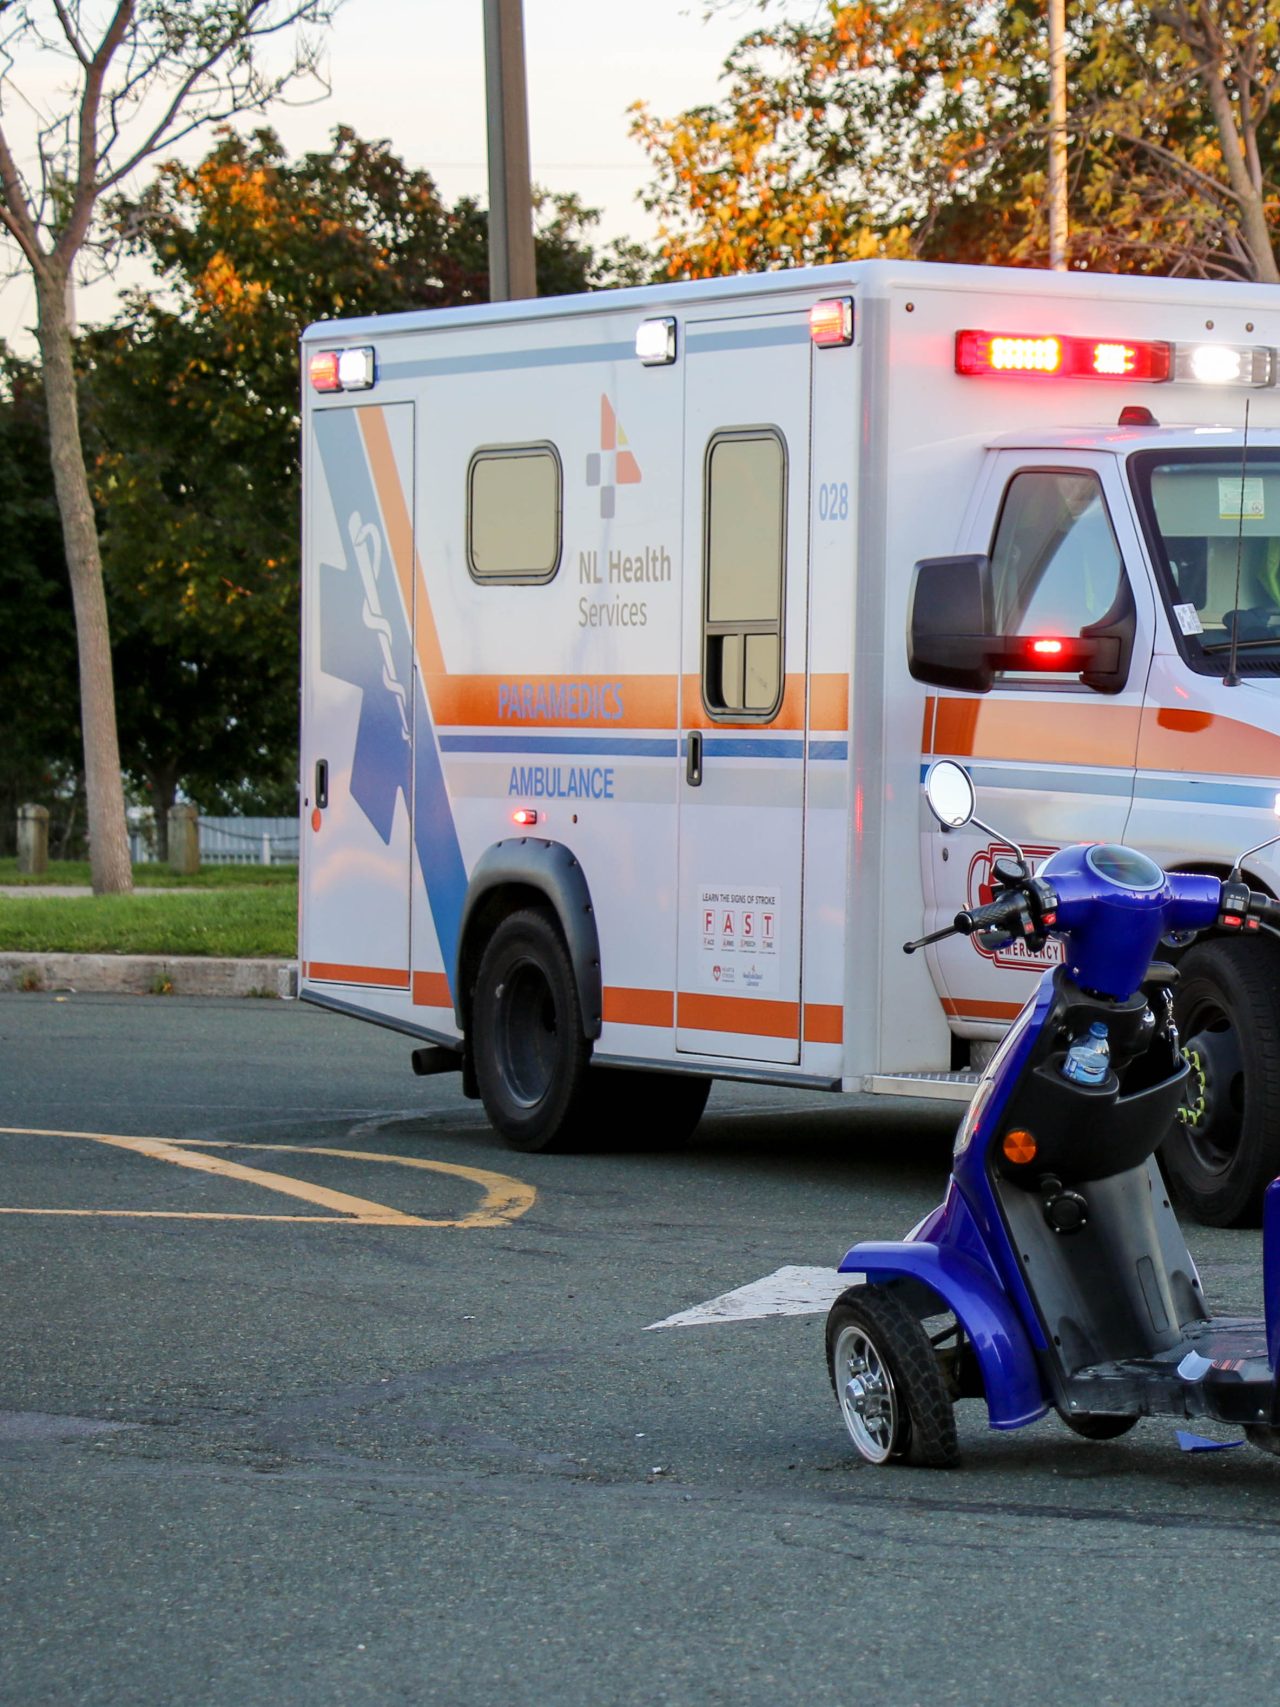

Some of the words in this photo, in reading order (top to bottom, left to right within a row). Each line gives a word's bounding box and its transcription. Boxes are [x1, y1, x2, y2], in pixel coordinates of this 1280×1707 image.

[819, 482, 849, 521] 028
[579, 550, 603, 584] NL
[608, 545, 671, 584] Health
[578, 593, 647, 628] Services
[498, 682, 624, 721] PARAMEDICS
[508, 766, 615, 799] AMBULANCE
[703, 893, 719, 902] LEARN
[720, 893, 729, 903] THE
[731, 894, 746, 904] SIGNS
[747, 895, 755, 904] OF
[755, 895, 776, 905] STROKE
